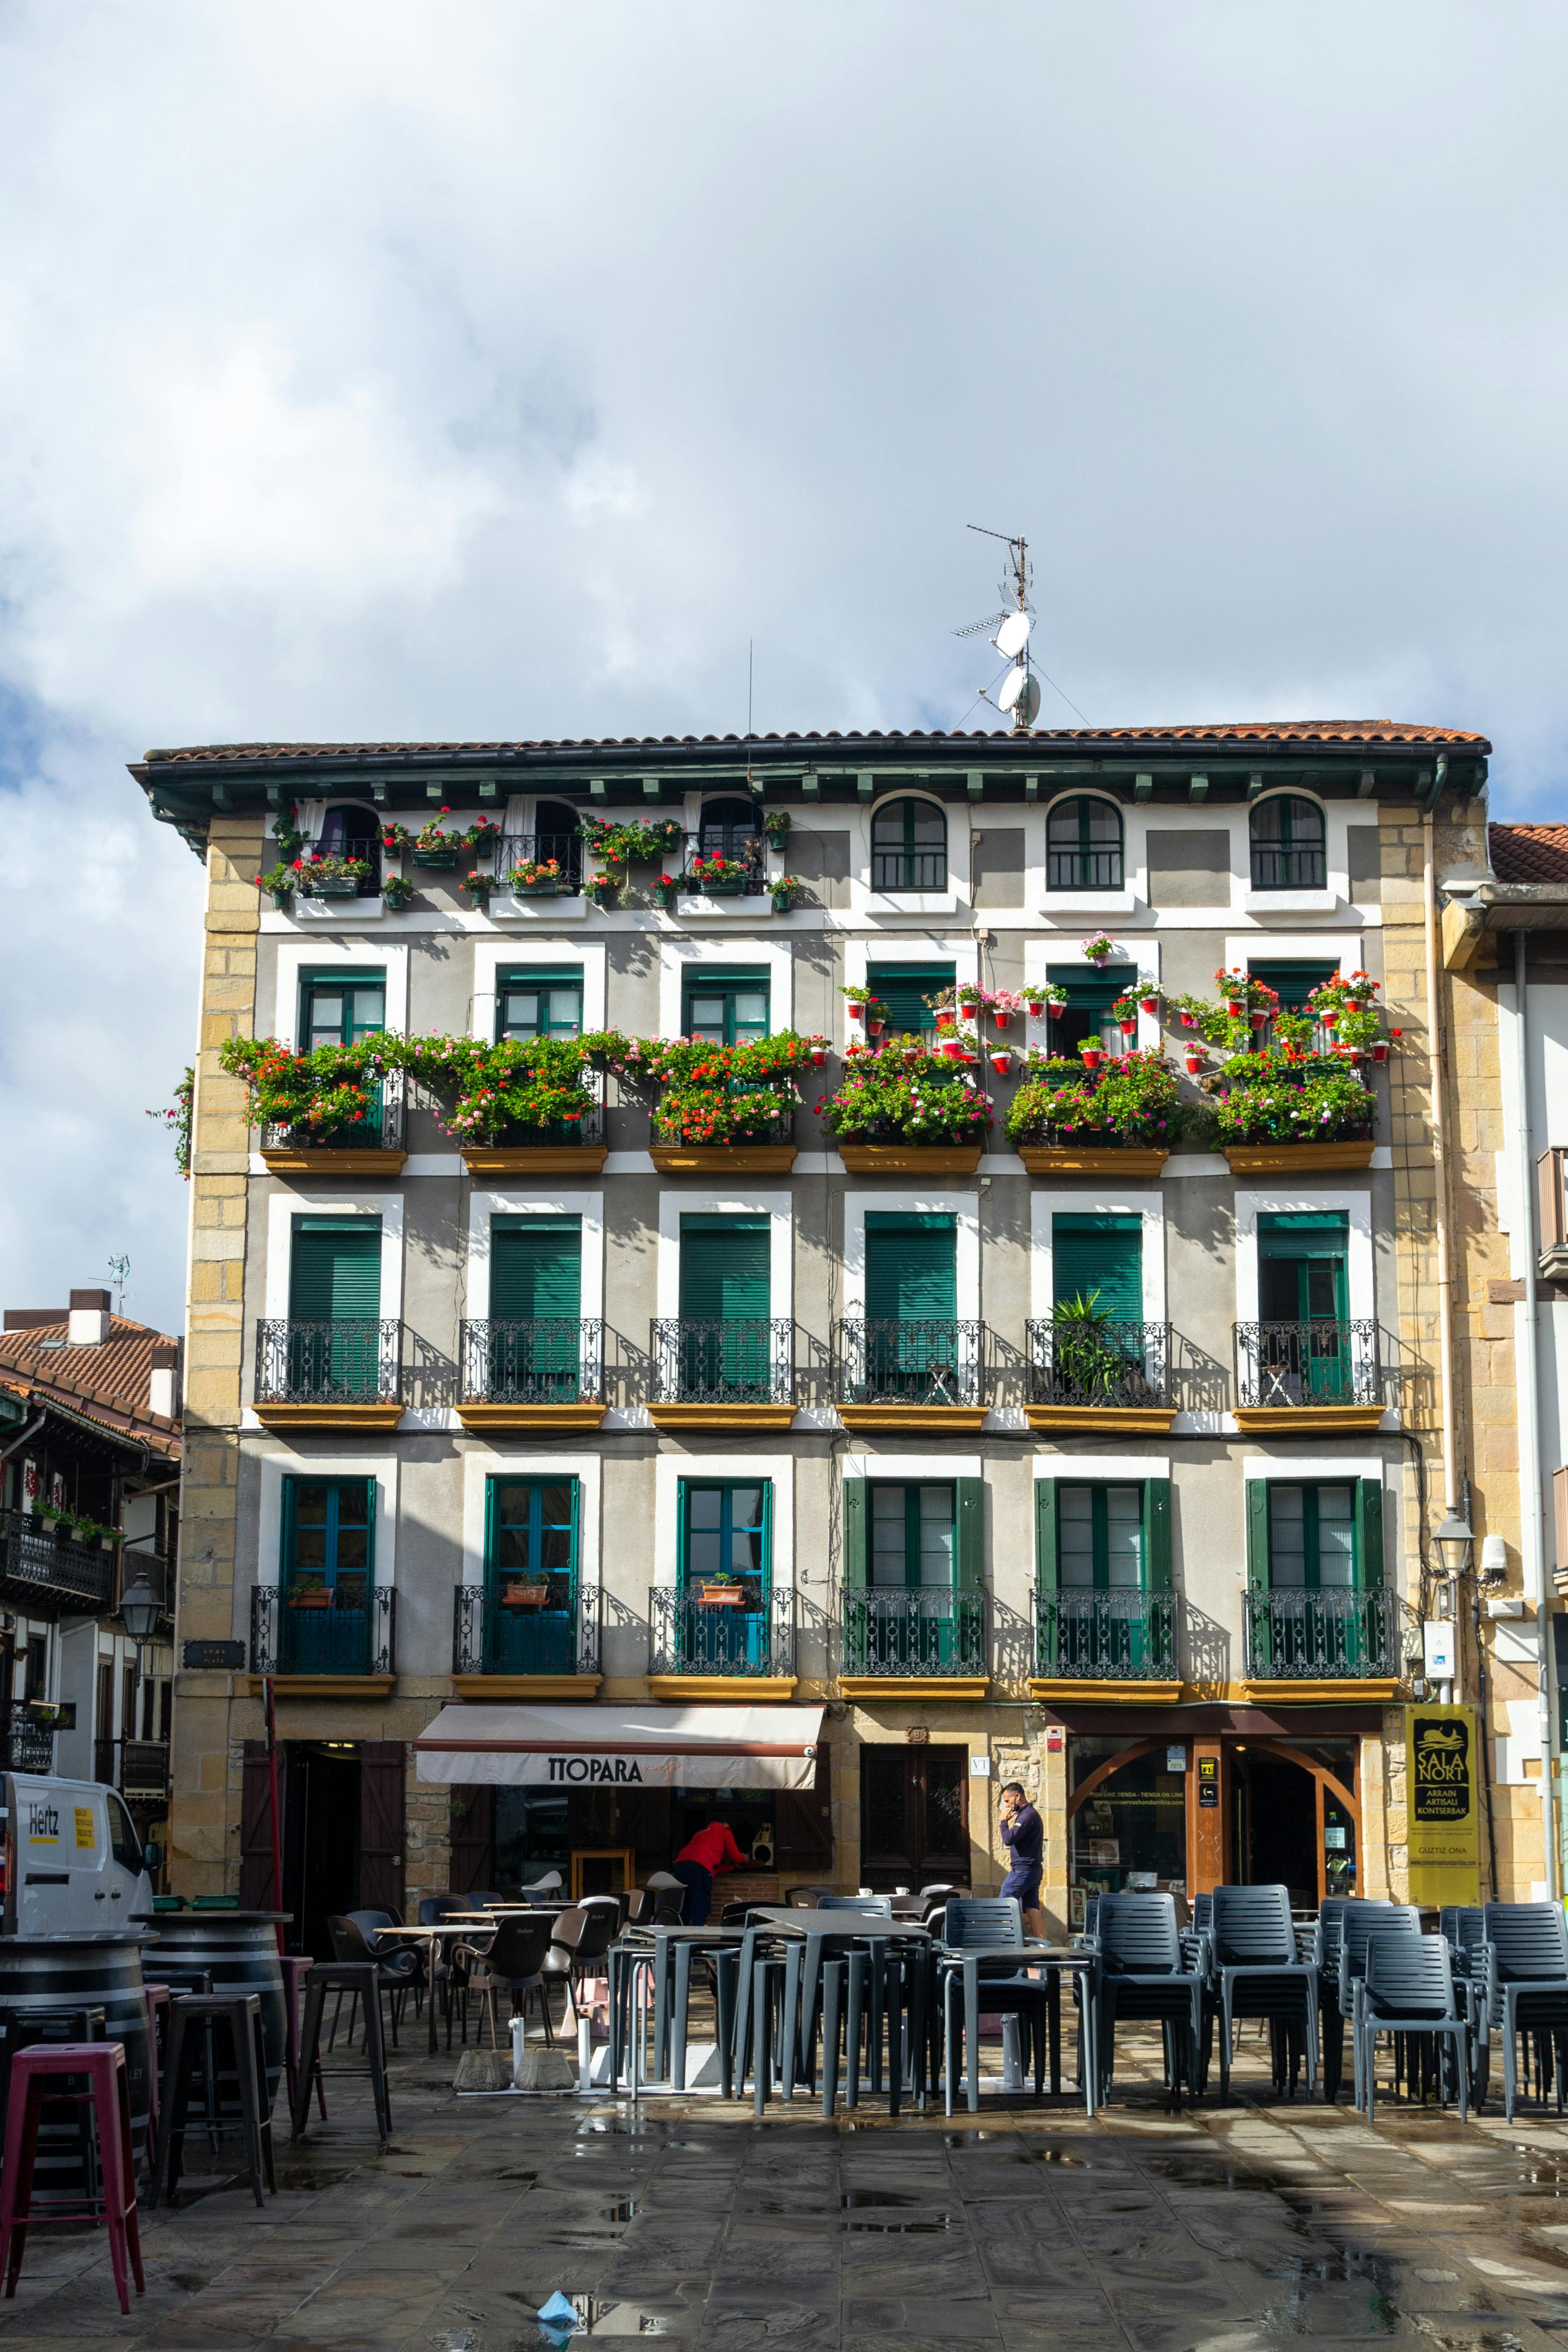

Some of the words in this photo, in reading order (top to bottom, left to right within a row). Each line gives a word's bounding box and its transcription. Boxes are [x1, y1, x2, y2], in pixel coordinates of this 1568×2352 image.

[972, 1759, 989, 1769] VT
[1418, 1752, 1464, 1769] SALA
[548, 1758, 643, 1782] TTOPARA
[1418, 1767, 1463, 1780] NORT
[30, 1803, 59, 1835] Hertz
